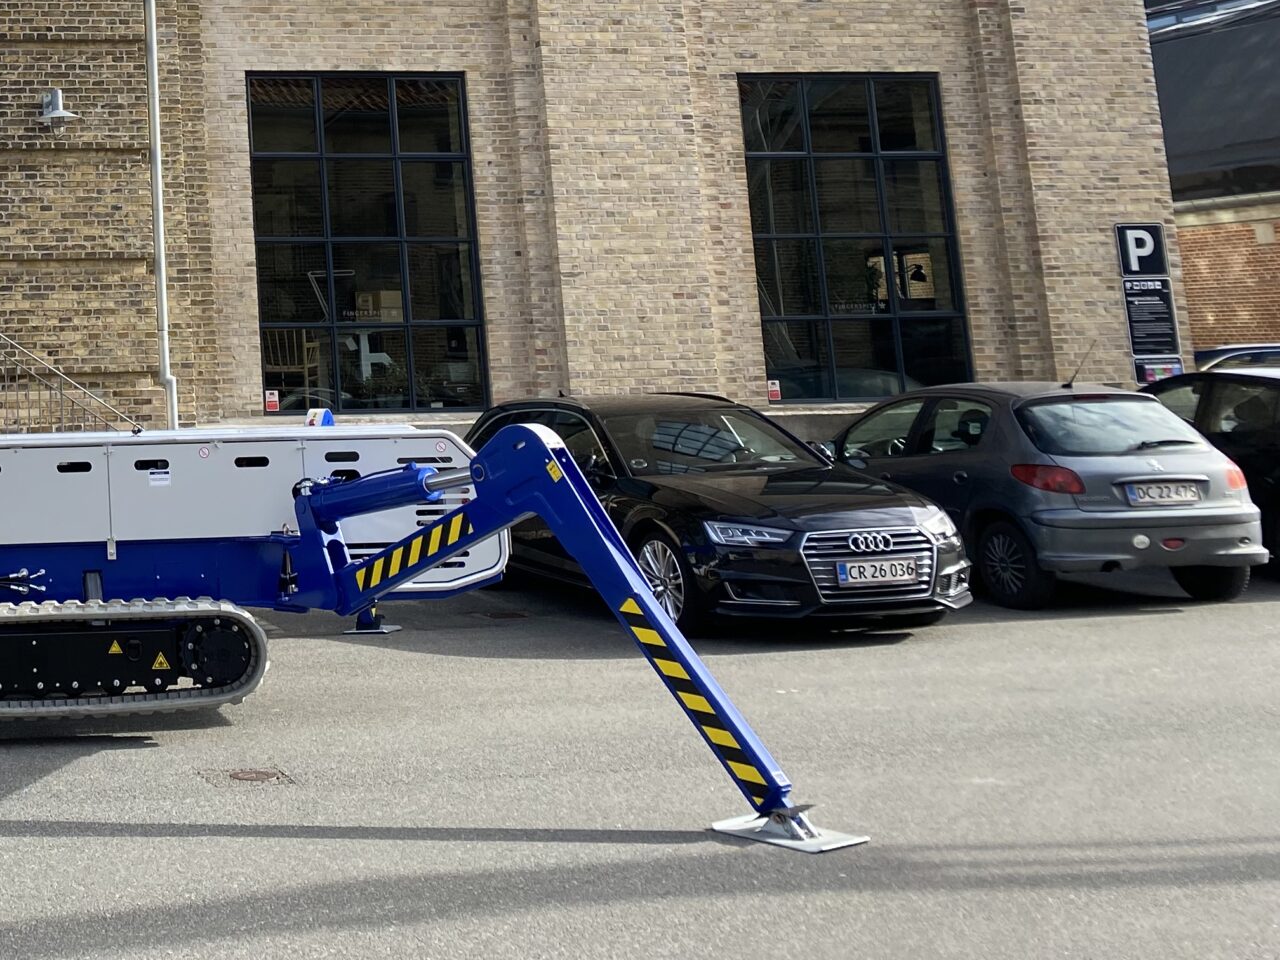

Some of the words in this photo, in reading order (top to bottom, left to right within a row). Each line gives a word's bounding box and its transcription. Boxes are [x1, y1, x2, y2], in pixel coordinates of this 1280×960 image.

[1125, 229, 1155, 272] P
[1137, 486, 1155, 500] DC
[1157, 486, 1173, 499] 22
[849, 565, 867, 580] CR
[870, 563, 887, 579] 26
[890, 561, 914, 577] 036
